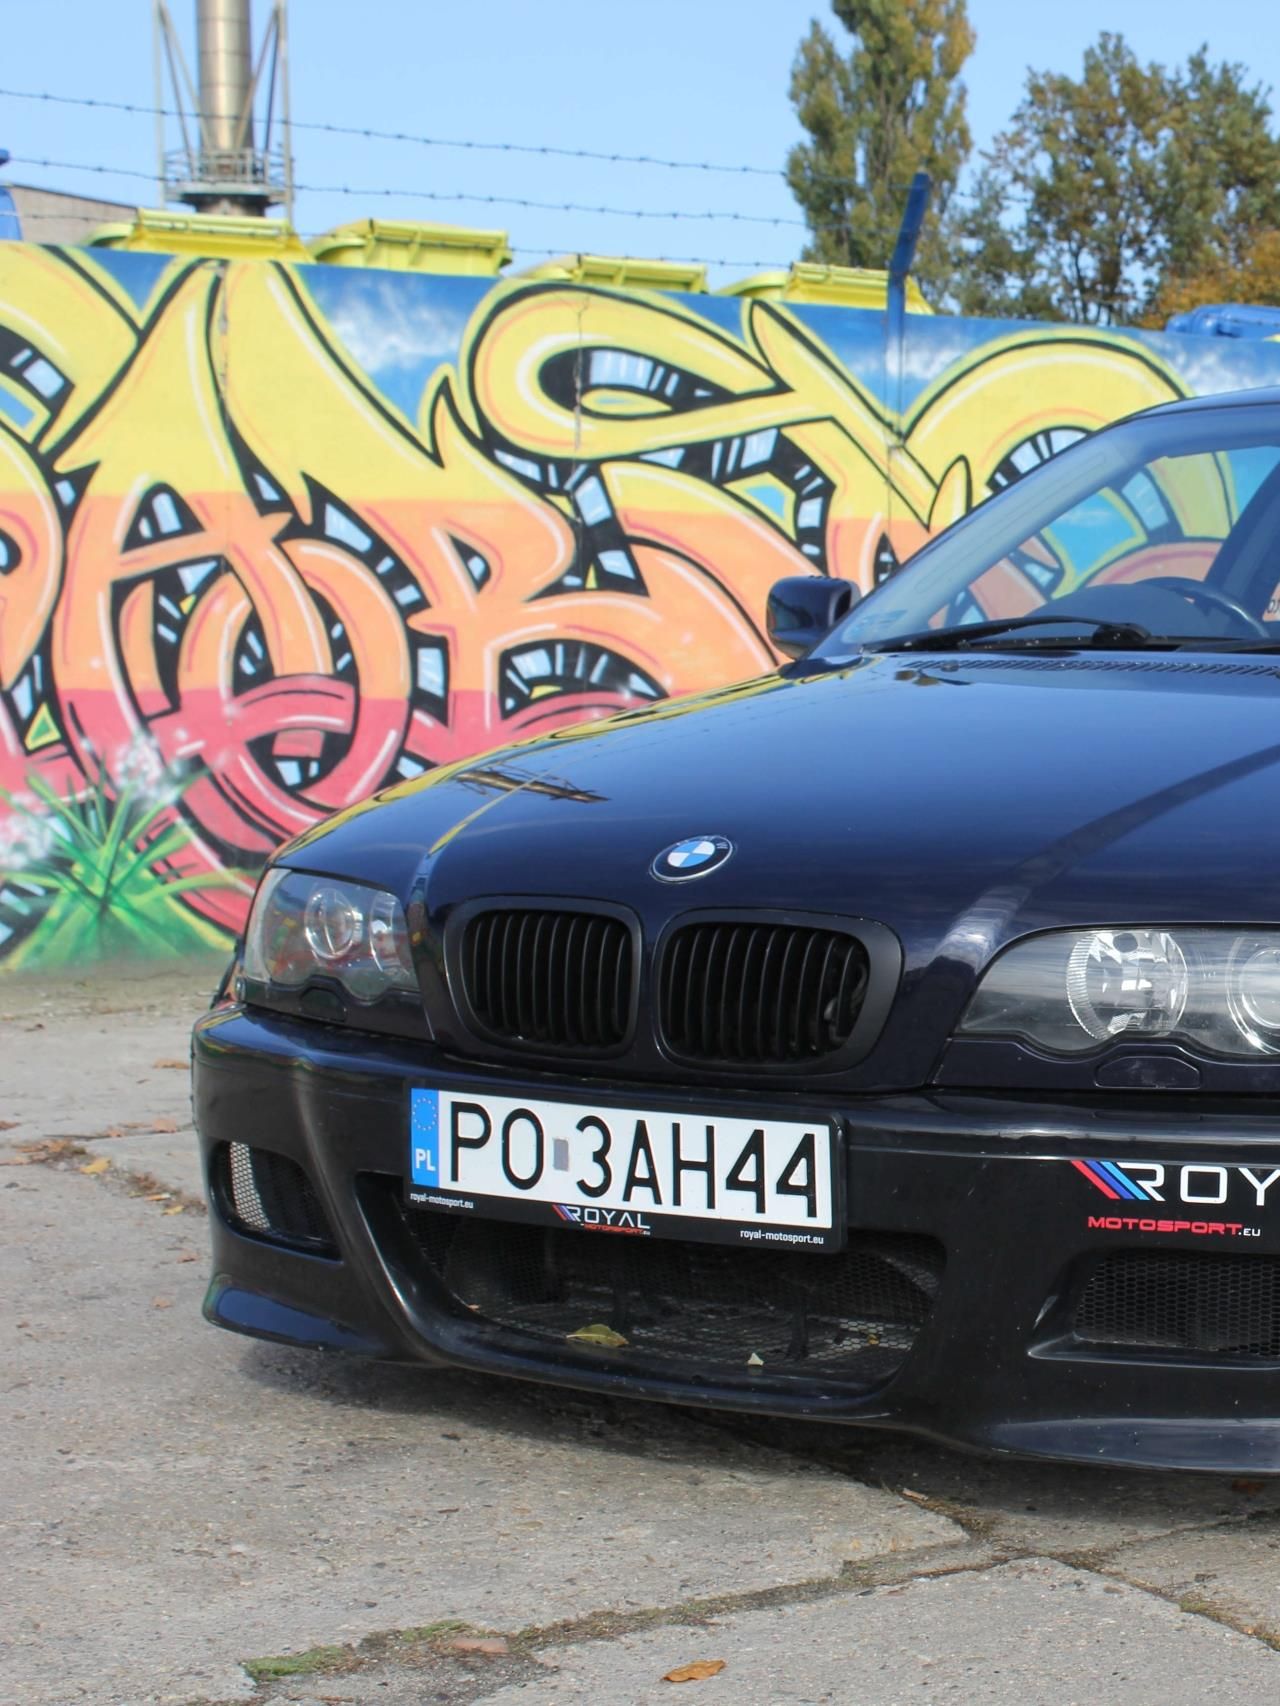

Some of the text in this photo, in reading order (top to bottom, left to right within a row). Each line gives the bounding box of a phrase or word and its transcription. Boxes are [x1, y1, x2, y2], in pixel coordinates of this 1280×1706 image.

[415, 1149, 436, 1172] PL
[450, 1101, 818, 1218] PO 3AH44
[567, 1205, 650, 1229] ROYAL
[1088, 1216, 1261, 1237] MOTOSPORT.EU
[740, 1230, 824, 1245] royal-motosport.eu
